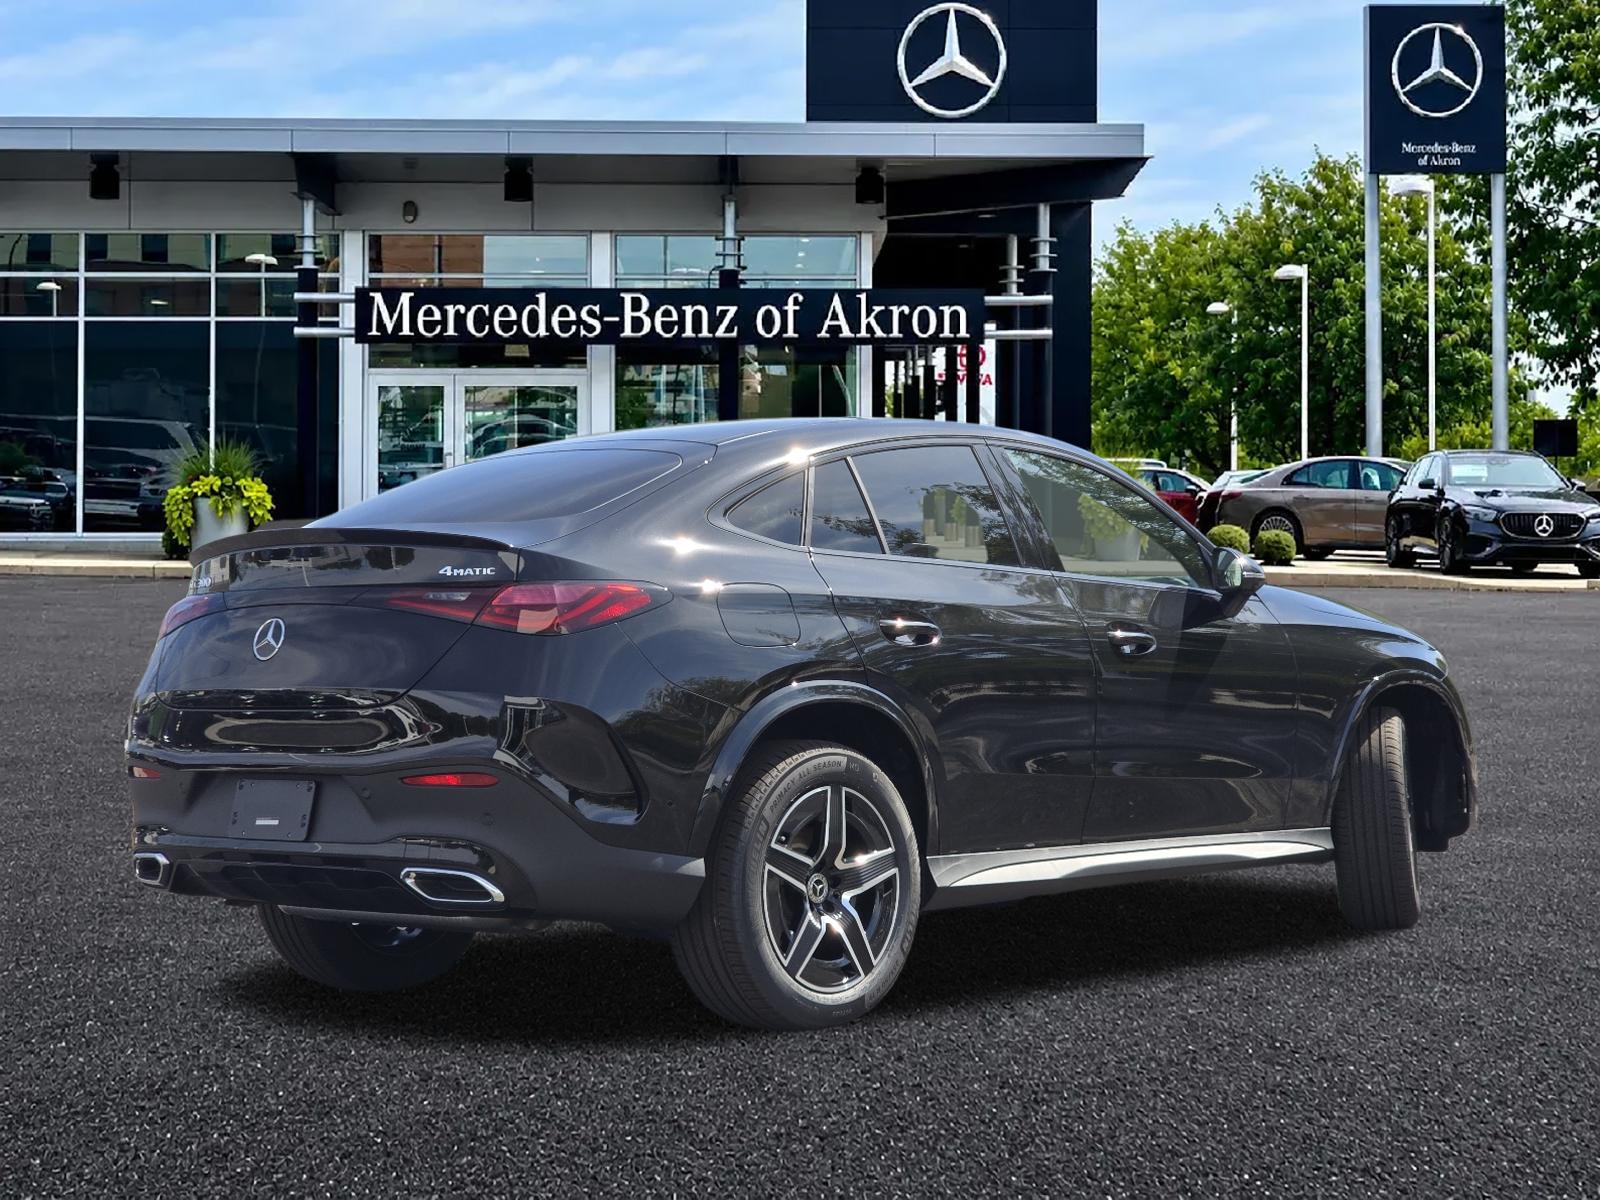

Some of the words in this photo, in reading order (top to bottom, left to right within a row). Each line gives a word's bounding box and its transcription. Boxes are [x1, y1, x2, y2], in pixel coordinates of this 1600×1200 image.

[1401, 141, 1477, 154] Mercedes-Benz
[1418, 154, 1429, 166] of
[1430, 154, 1461, 166] Akron
[367, 291, 738, 338] Mercedes-Benz
[755, 292, 804, 338] of
[816, 291, 971, 338] Akron
[438, 565, 496, 576] 4MATIC
[813, 760, 842, 772] SEASON
